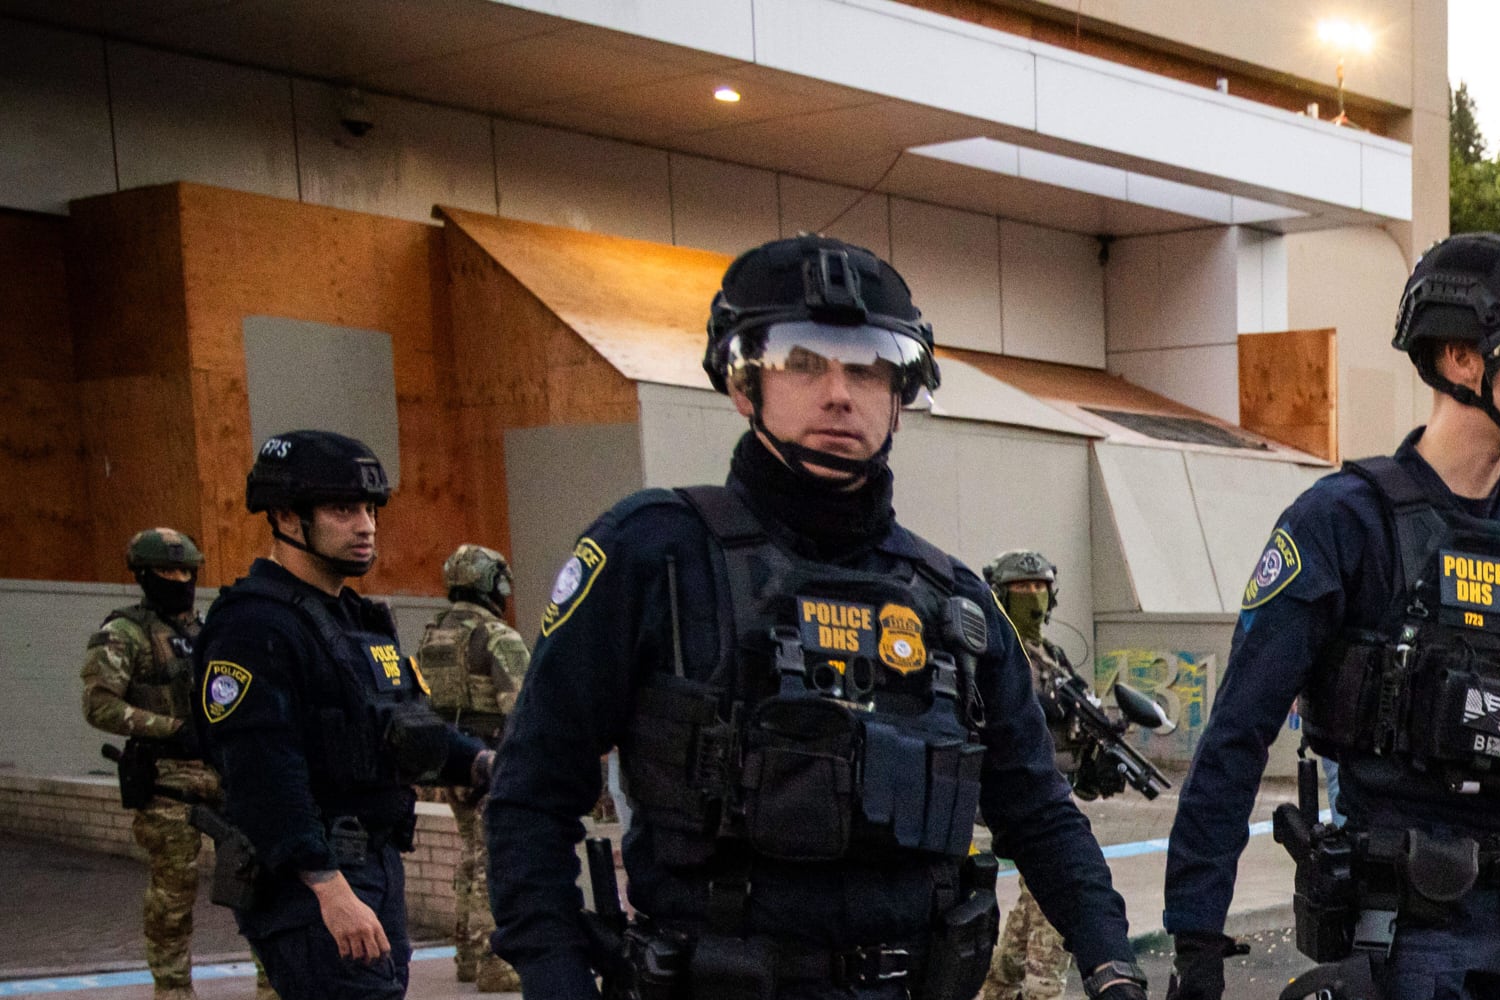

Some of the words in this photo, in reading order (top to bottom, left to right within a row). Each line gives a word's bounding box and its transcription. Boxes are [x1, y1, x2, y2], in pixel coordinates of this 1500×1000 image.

[261, 438, 292, 459] FPS
[1456, 579, 1493, 606] DHS
[802, 601, 873, 631] POLICE
[818, 625, 859, 652] DHS
[370, 645, 400, 663] POLICE
[213, 665, 247, 684] POLICE
